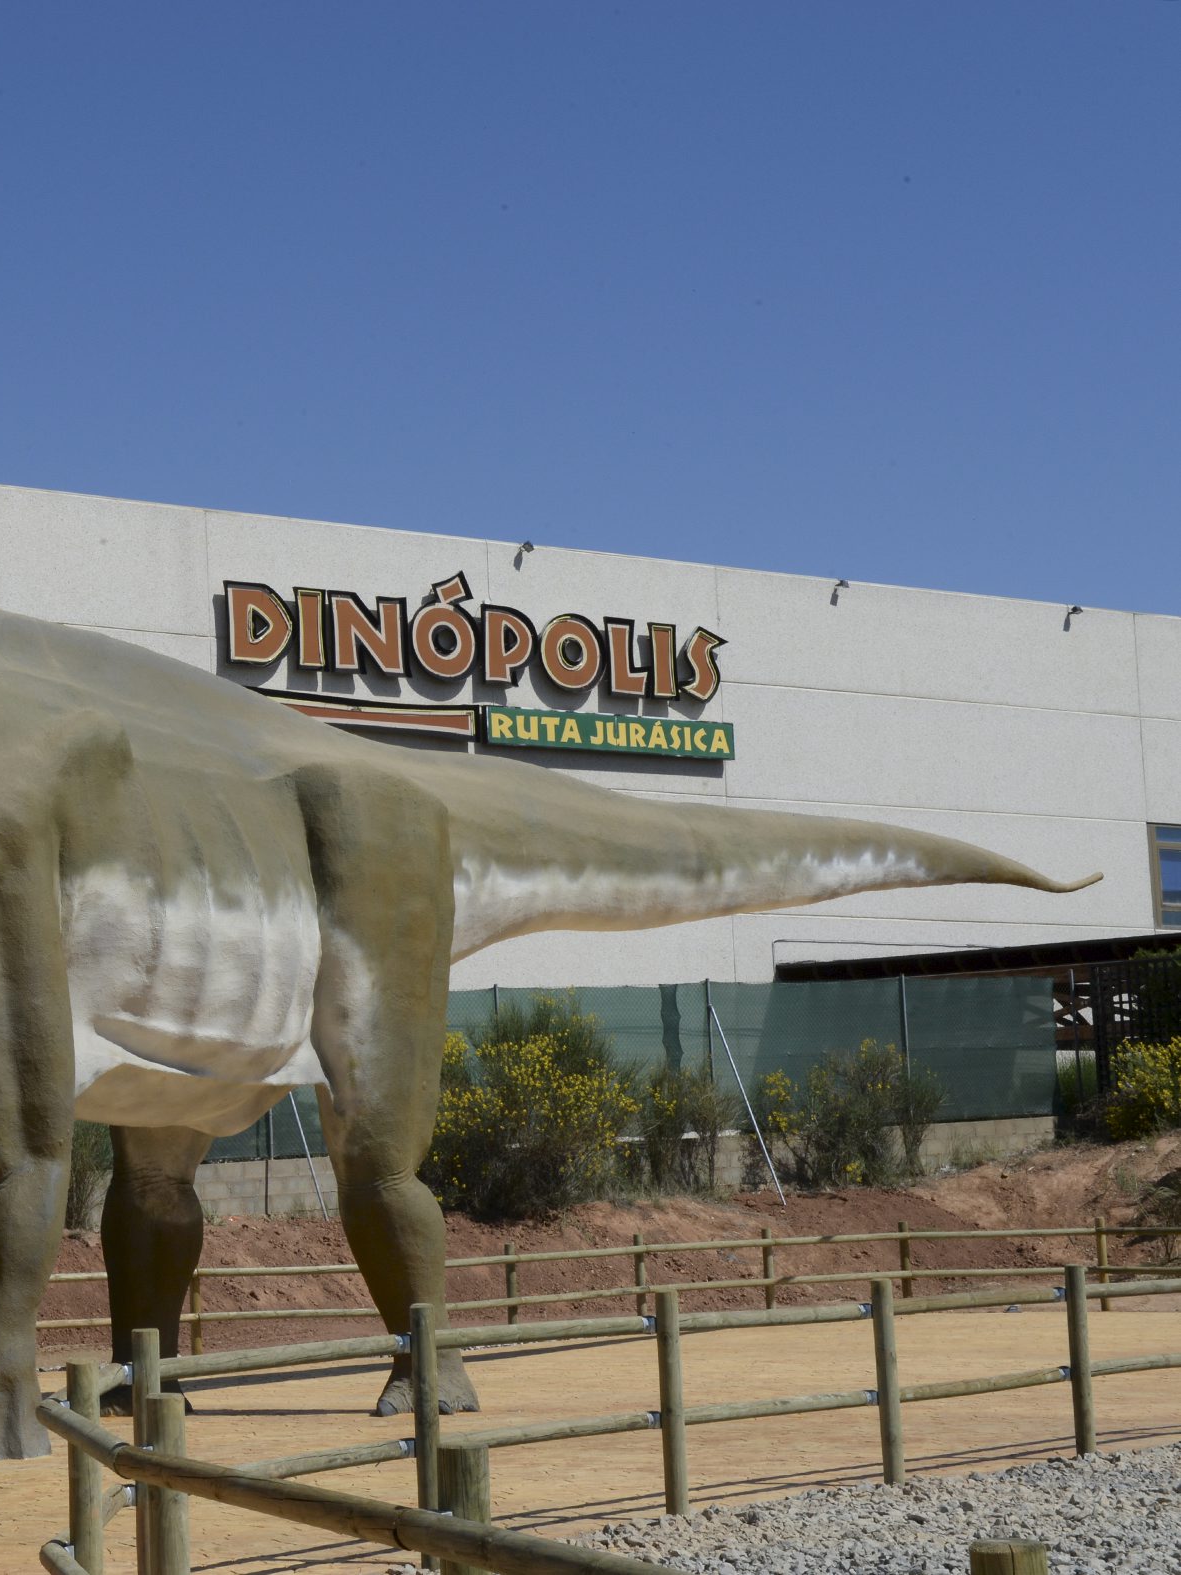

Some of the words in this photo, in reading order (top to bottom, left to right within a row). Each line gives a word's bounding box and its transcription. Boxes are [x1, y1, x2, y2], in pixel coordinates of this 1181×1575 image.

[223, 570, 728, 702] DINÓPOLIS
[491, 711, 582, 745] RUTA
[590, 716, 730, 754] JURÁSICA
